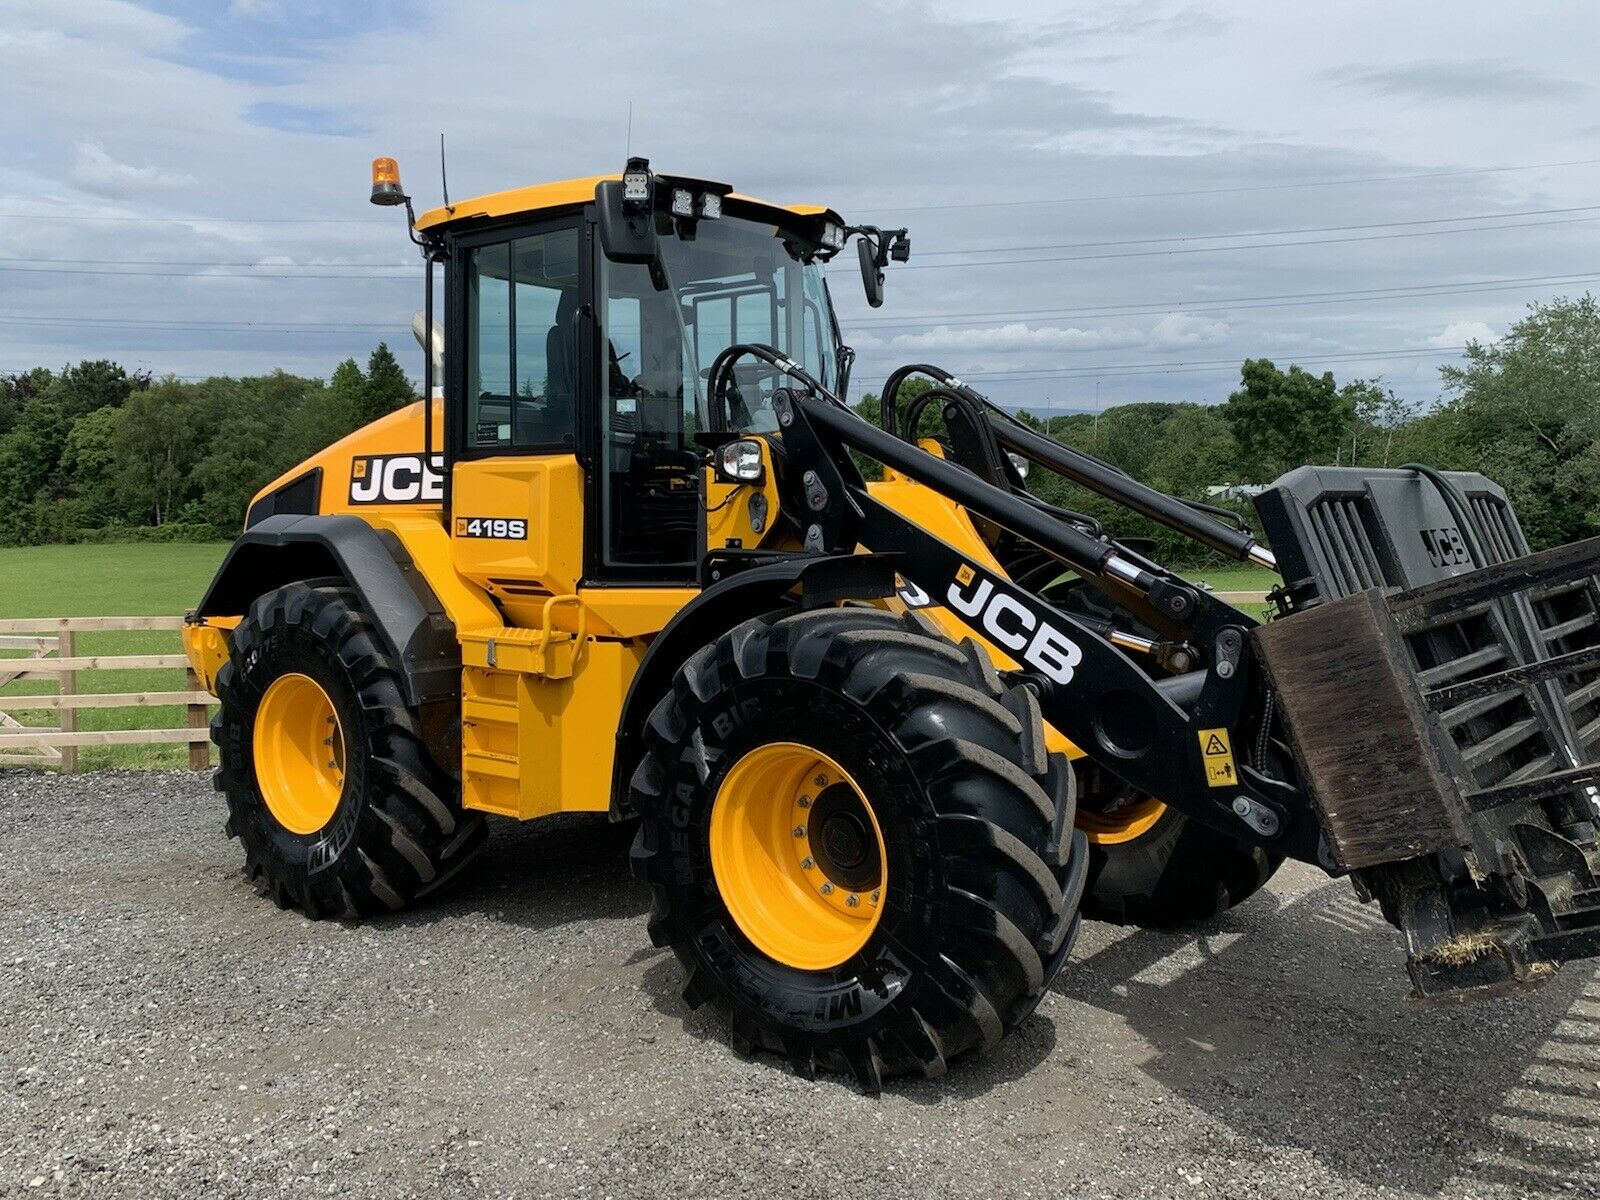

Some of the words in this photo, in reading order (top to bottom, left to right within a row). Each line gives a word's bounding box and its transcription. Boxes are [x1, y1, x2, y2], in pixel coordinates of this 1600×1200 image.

[467, 519, 525, 538] 419S
[1420, 528, 1470, 568] JCB
[947, 578, 1083, 686] JCB
[680, 724, 726, 786] X
